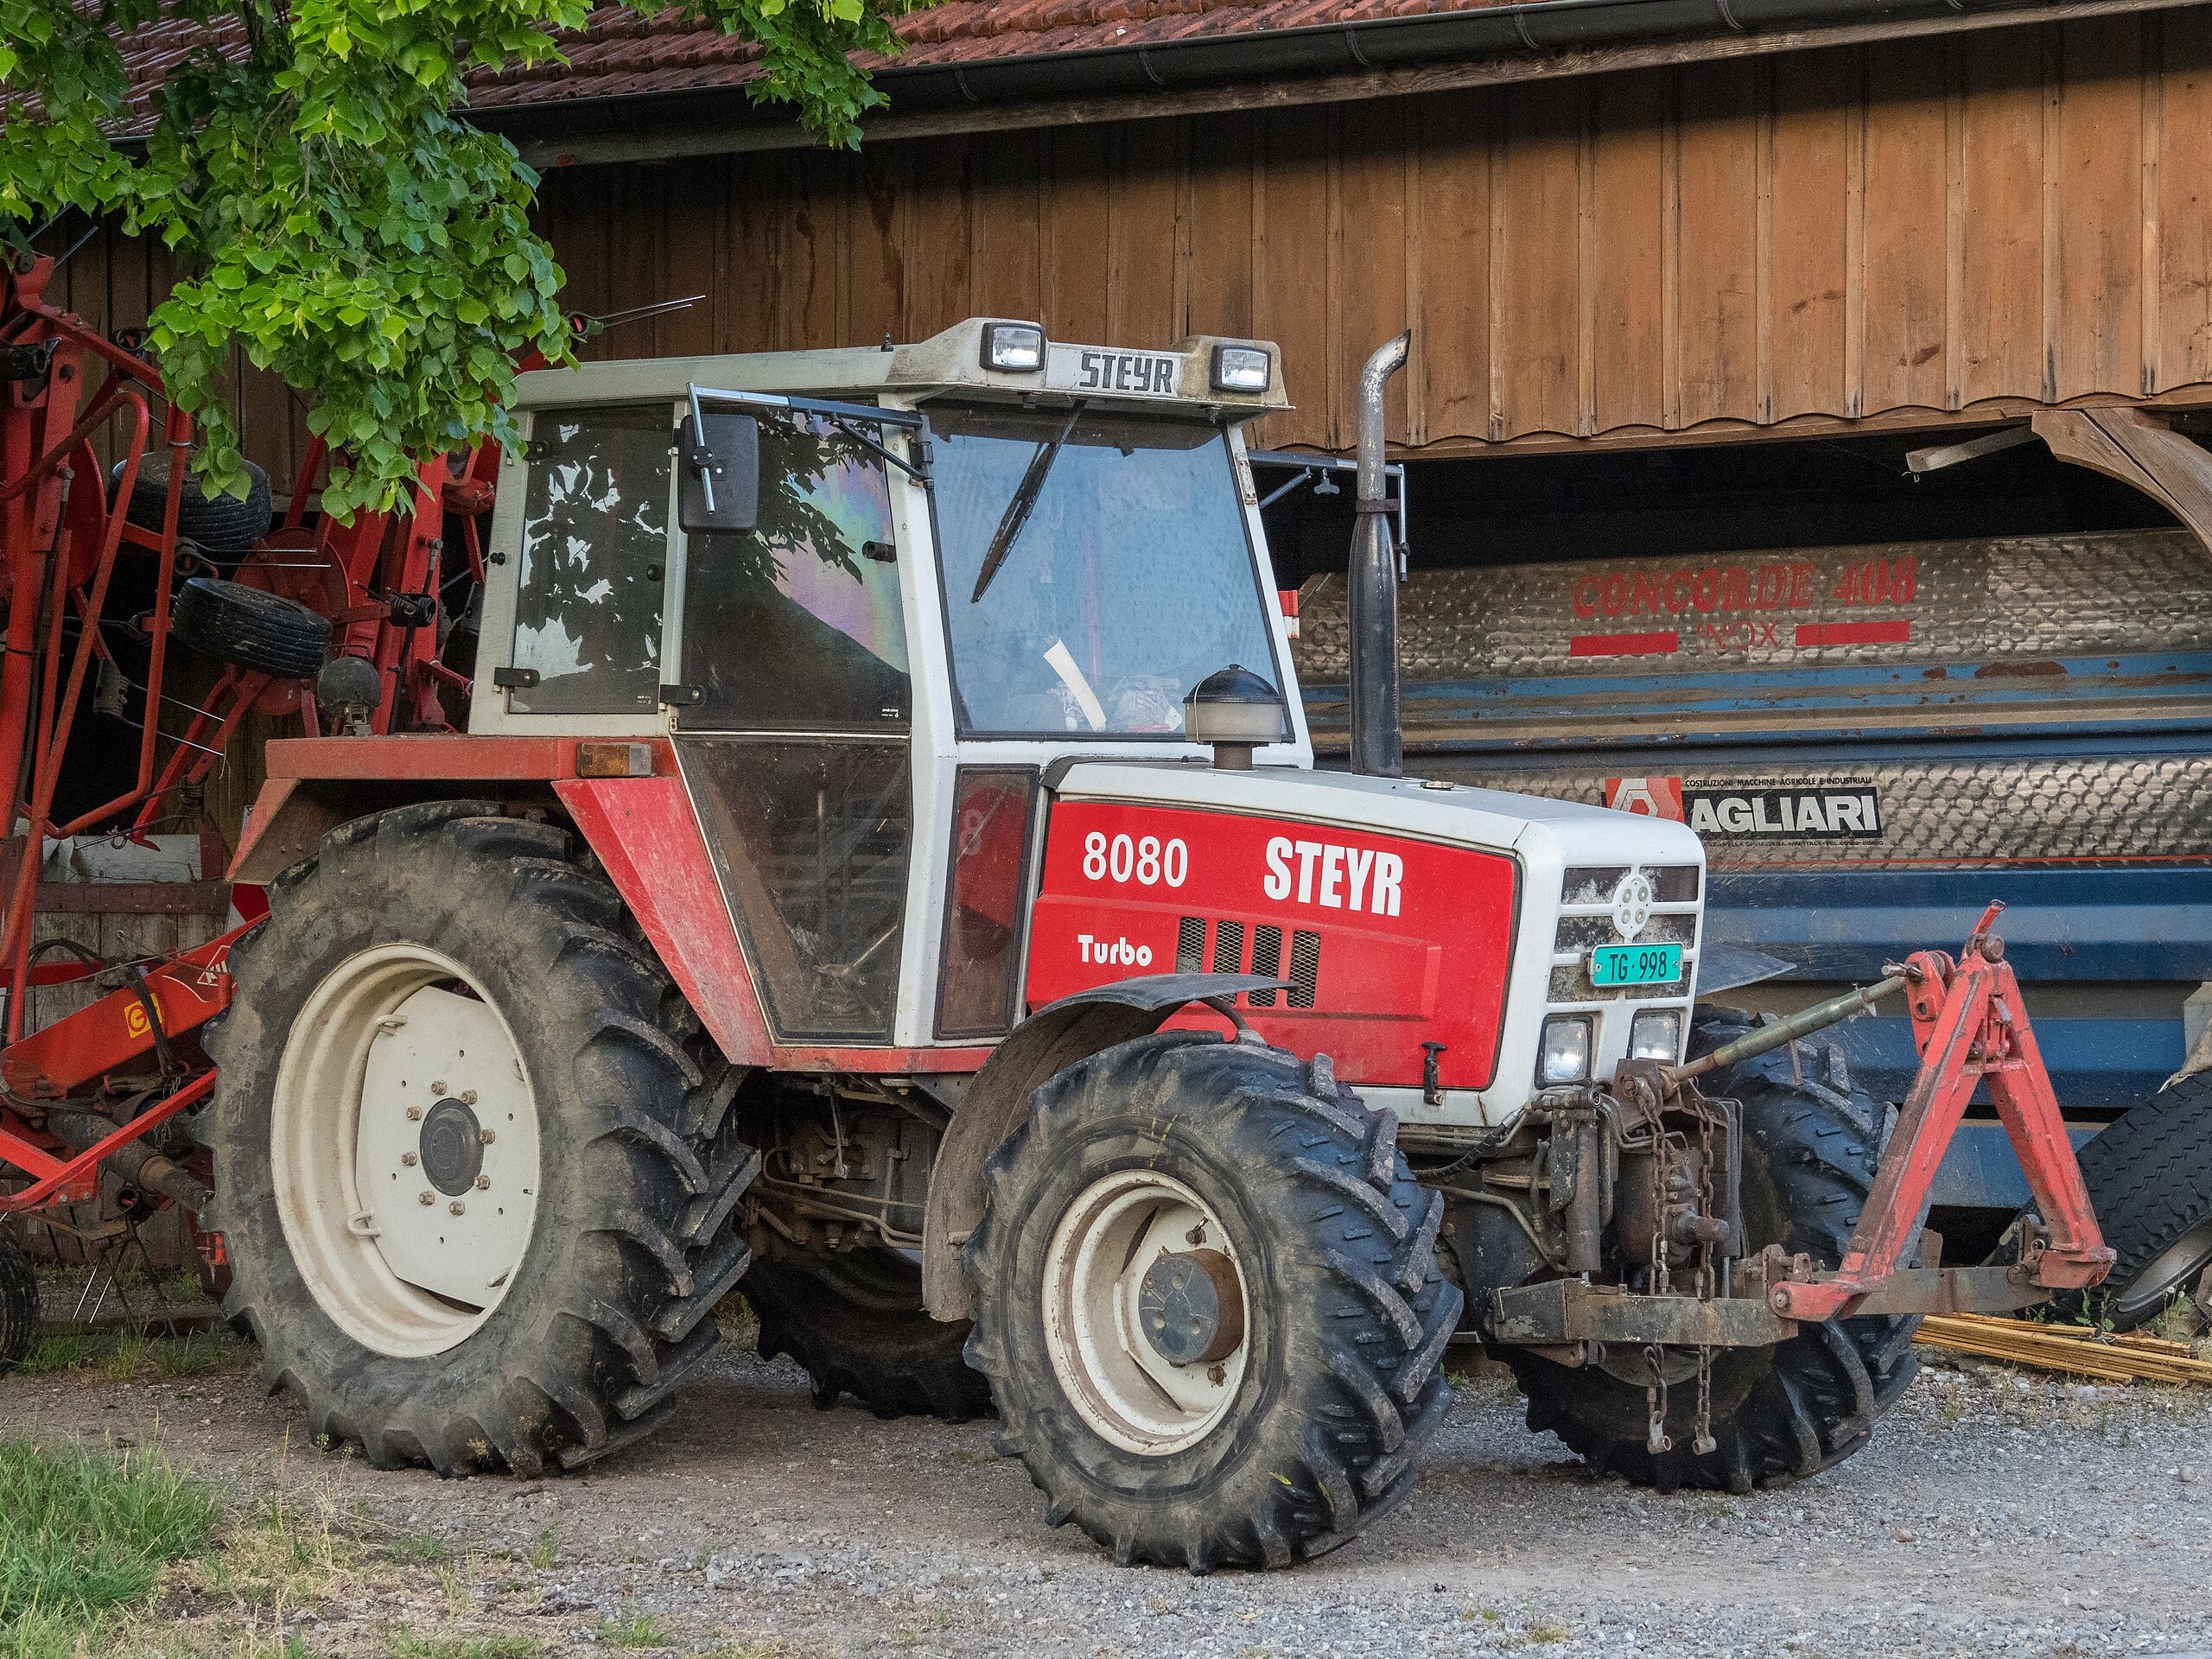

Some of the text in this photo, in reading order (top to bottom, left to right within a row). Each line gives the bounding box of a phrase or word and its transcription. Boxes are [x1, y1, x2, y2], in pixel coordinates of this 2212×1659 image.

[1079, 353, 1173, 394] STEYR
[1573, 556, 1917, 618] CONCORDE 408
[1696, 620, 1779, 651] INOX
[1685, 779, 1733, 787] COSTRUZIONI
[1737, 778, 1776, 786] MACCHINE
[1779, 777, 1816, 785] AGRICOLE
[1827, 776, 1872, 785] INDUSTRIALI
[1690, 795, 1878, 833] AGLIARI
[1082, 830, 1404, 918] 8080 STEYR
[1077, 934, 1153, 968] Turbo
